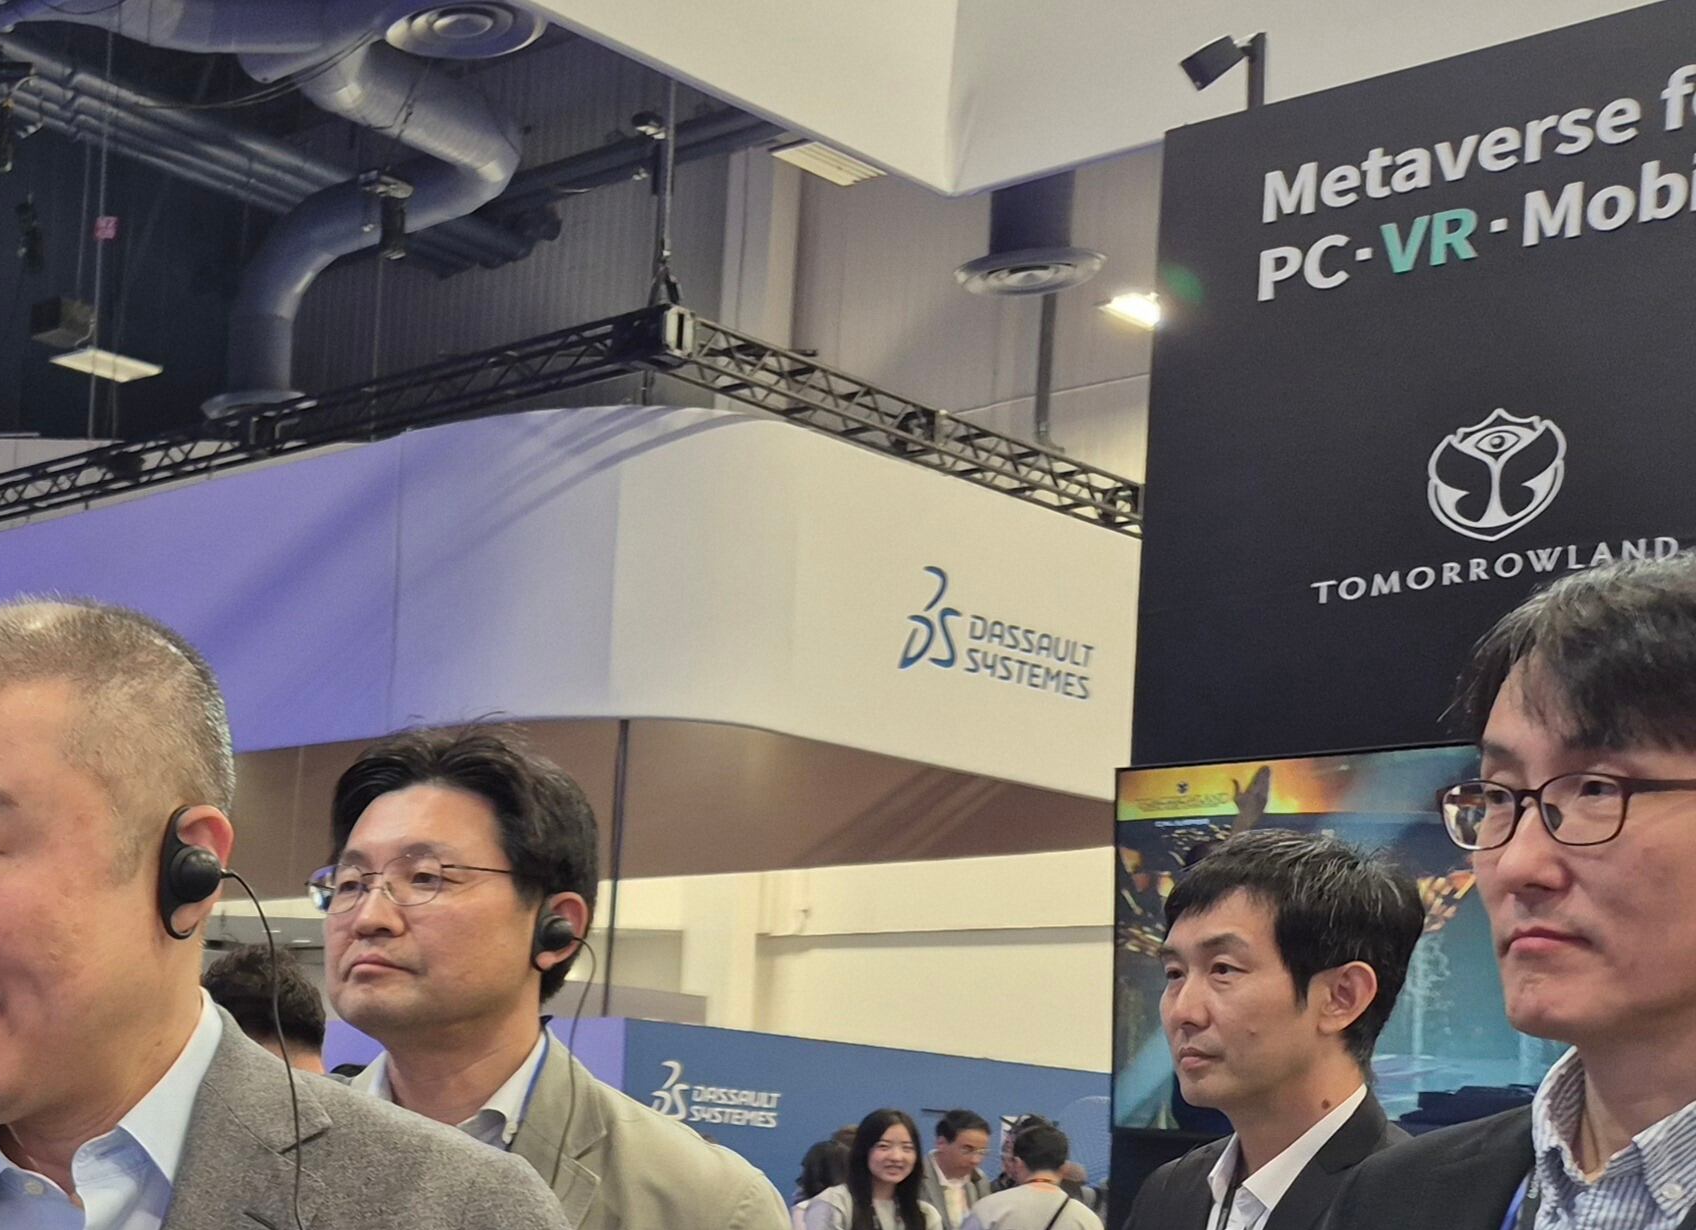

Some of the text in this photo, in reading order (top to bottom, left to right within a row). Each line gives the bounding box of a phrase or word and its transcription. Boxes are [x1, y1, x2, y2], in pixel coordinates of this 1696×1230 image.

[1261, 63, 1696, 224] Metaverse f
[1310, 536, 1679, 604] TOMORROWLAND
[968, 614, 1094, 668] DASSAULT
[963, 647, 1091, 700] SYSTEMES
[688, 1105, 778, 1129] SYSTEMES
[691, 1085, 782, 1109] DASSAULT
